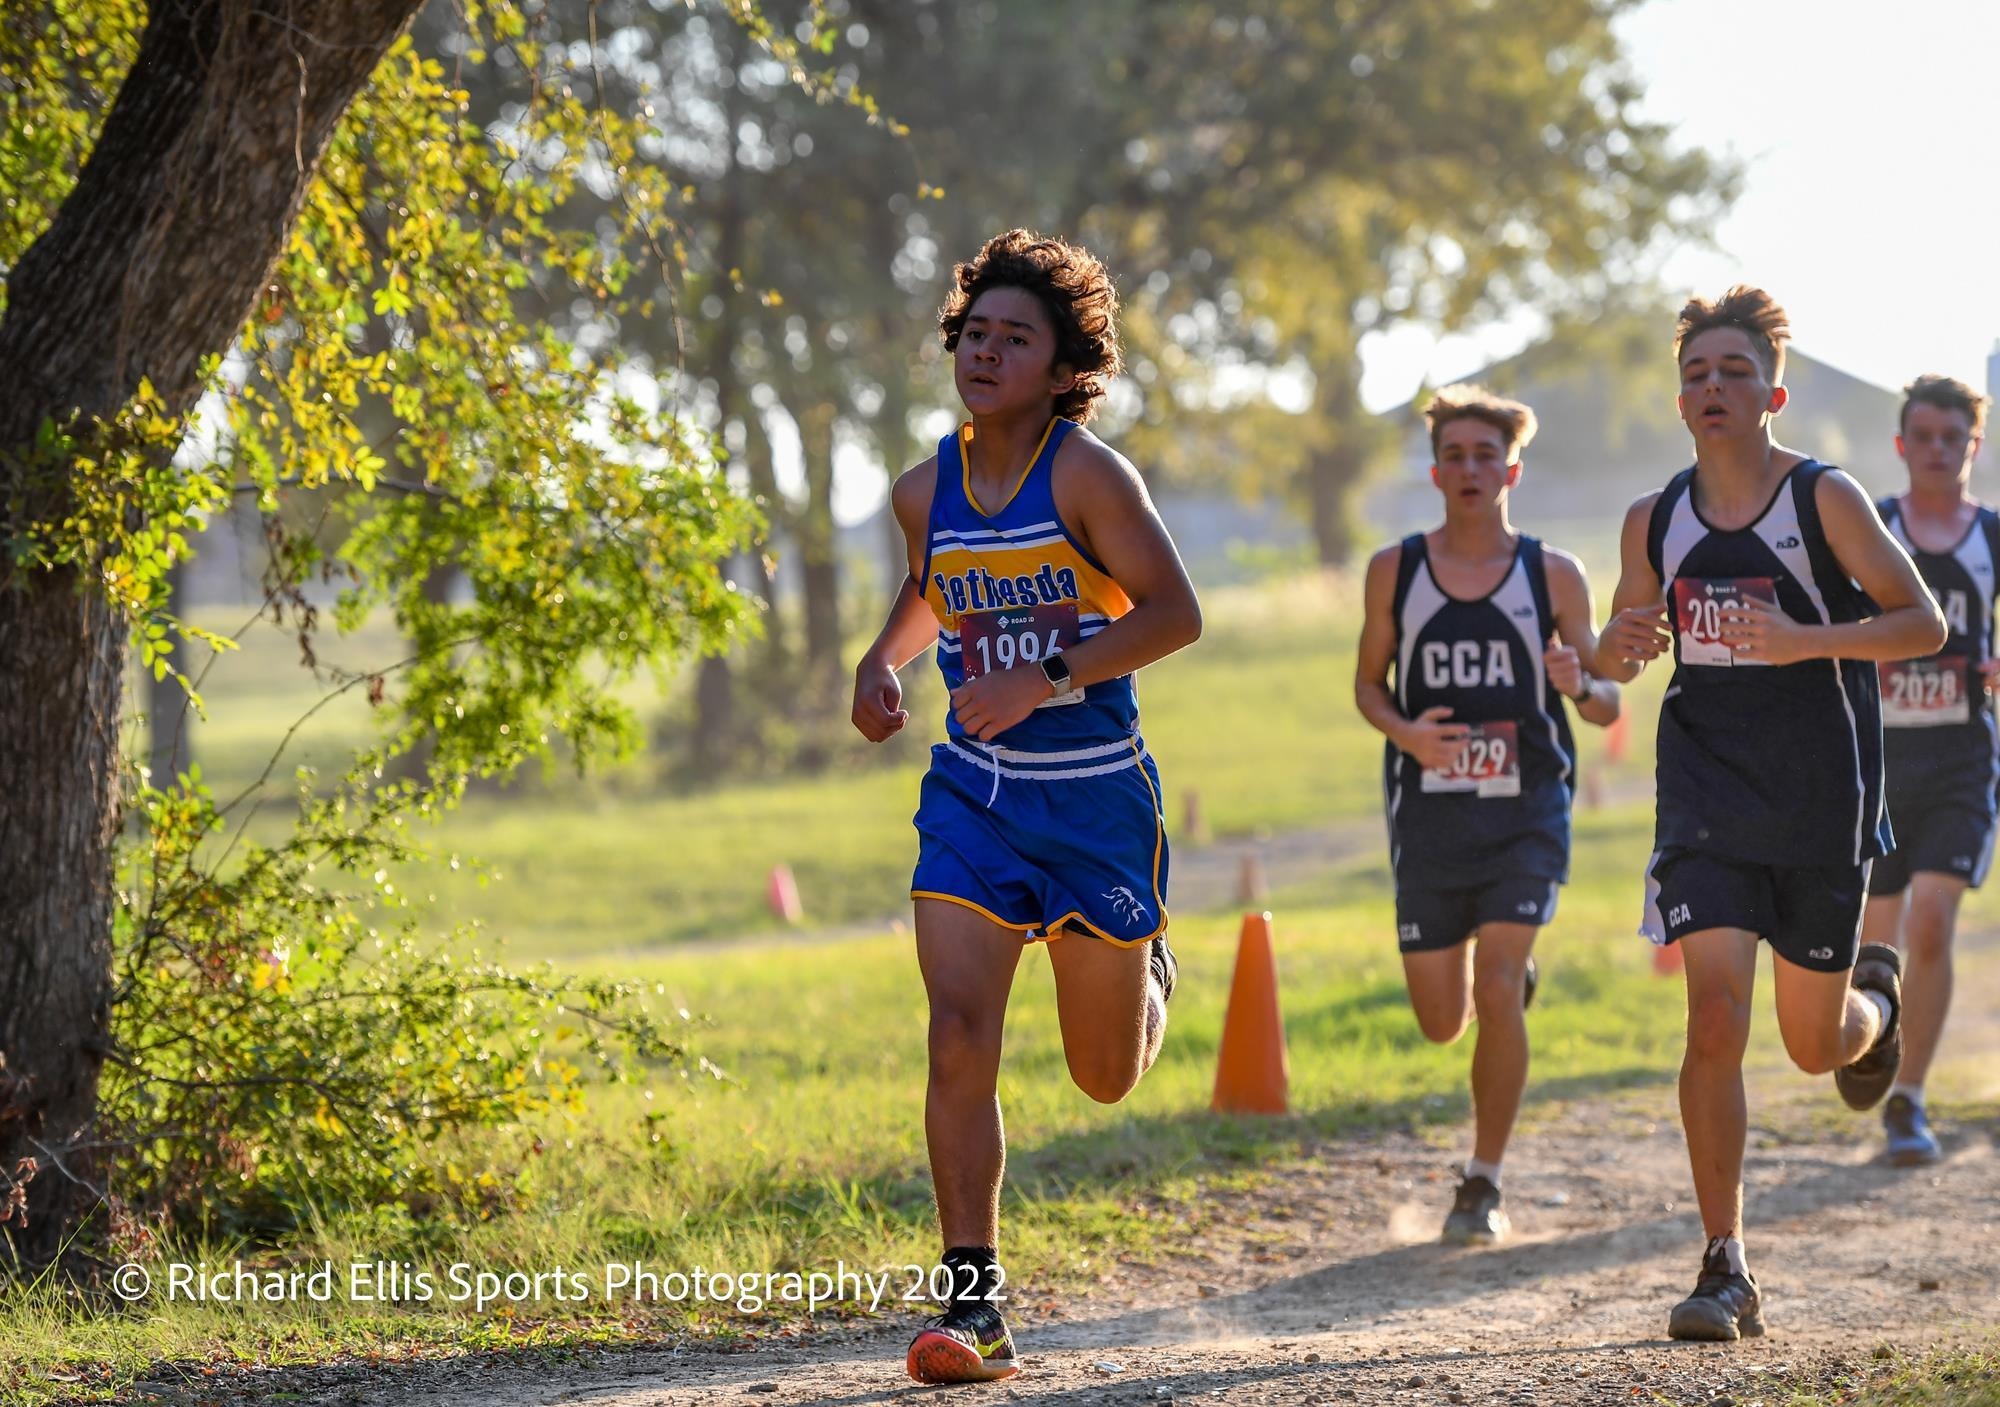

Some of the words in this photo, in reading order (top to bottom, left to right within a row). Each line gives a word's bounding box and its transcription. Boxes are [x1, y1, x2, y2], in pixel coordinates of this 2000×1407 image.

[1688, 598, 1750, 640] 20
[976, 629, 1064, 675] 1996
[1422, 639, 1516, 689] CCA
[1436, 737, 1507, 776] 029
[1669, 903, 1691, 928] CCA
